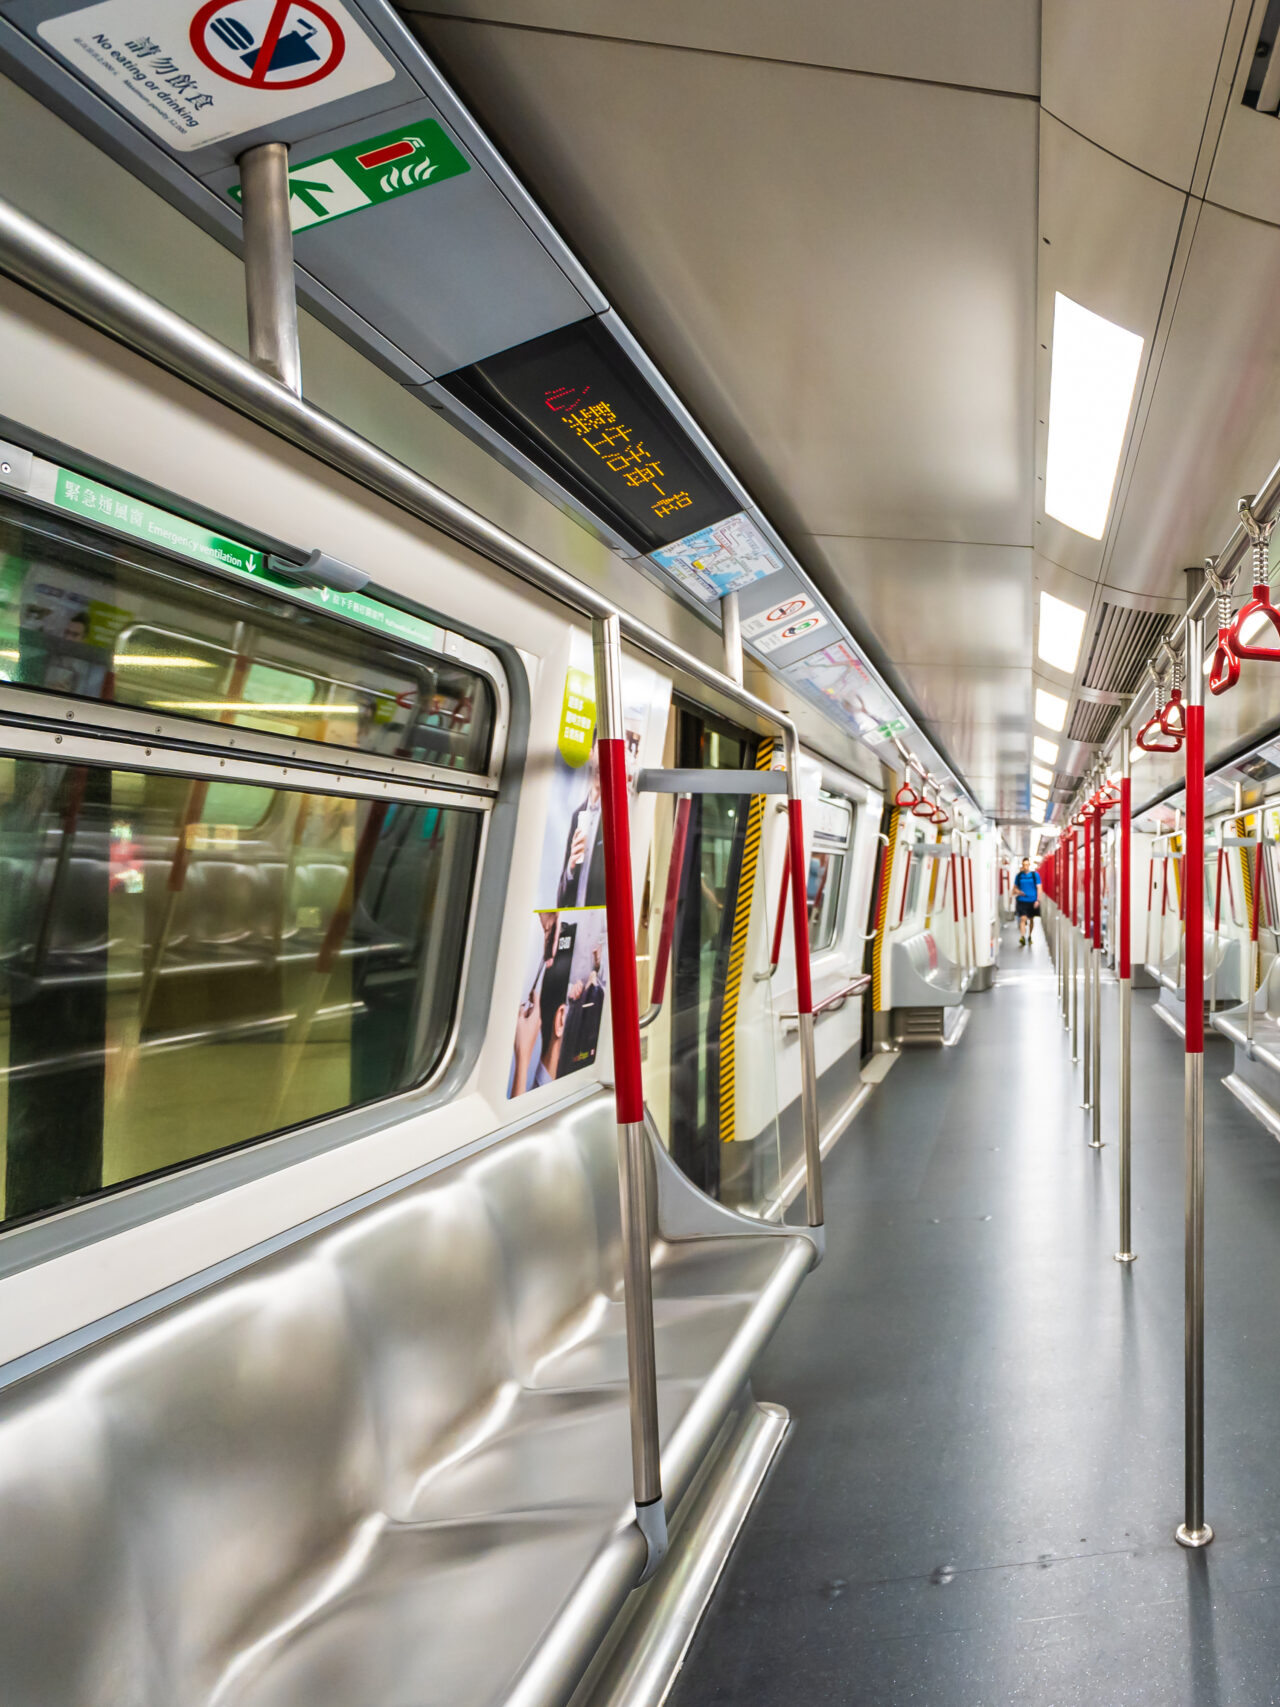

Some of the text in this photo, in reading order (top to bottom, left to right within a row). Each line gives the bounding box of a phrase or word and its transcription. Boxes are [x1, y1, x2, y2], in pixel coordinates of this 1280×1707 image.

[92, 34, 112, 50] No
[110, 50, 147, 81] eating
[145, 80, 160, 91] or
[157, 91, 199, 128] drinking
[124, 36, 215, 111] 請勿飲食
[148, 521, 242, 567] Emergency ventilation
